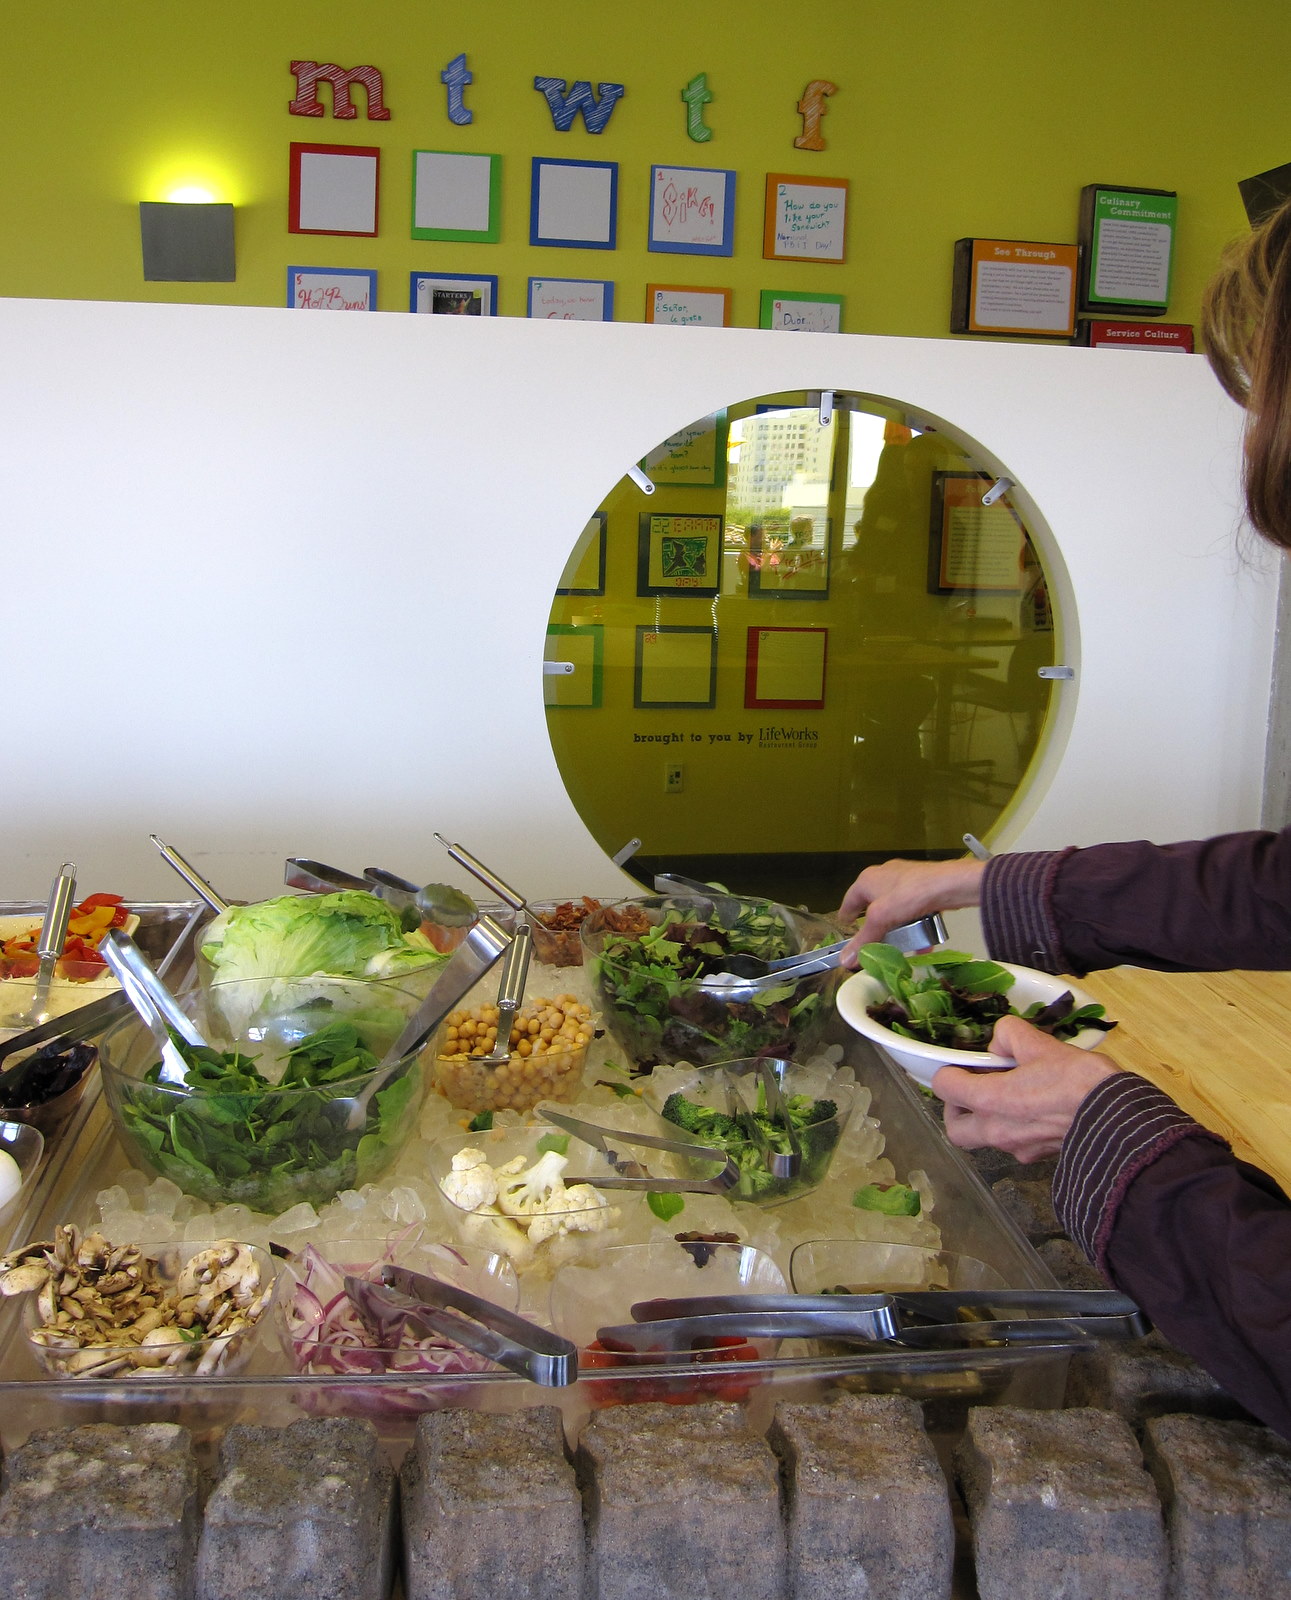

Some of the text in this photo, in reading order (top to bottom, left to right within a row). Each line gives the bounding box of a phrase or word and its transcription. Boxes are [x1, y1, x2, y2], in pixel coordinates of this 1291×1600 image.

[288, 52, 839, 152] m t w t f
[657, 171, 664, 181] 1
[778, 185, 787, 196] 2
[784, 199, 839, 212] How do you
[1099, 196, 1141, 209] Culinary
[806, 213, 825, 224] your
[1110, 207, 1172, 219] Commitment
[994, 247, 1056, 260] See Through
[418, 280, 425, 291] 6
[534, 282, 542, 291] 7
[433, 292, 468, 300] STARTERS
[656, 292, 664, 301] 8
[775, 302, 781, 313] 9
[1106, 328, 1179, 339] Service Culture
[633, 726, 819, 745] brought to you by LifeWorks
